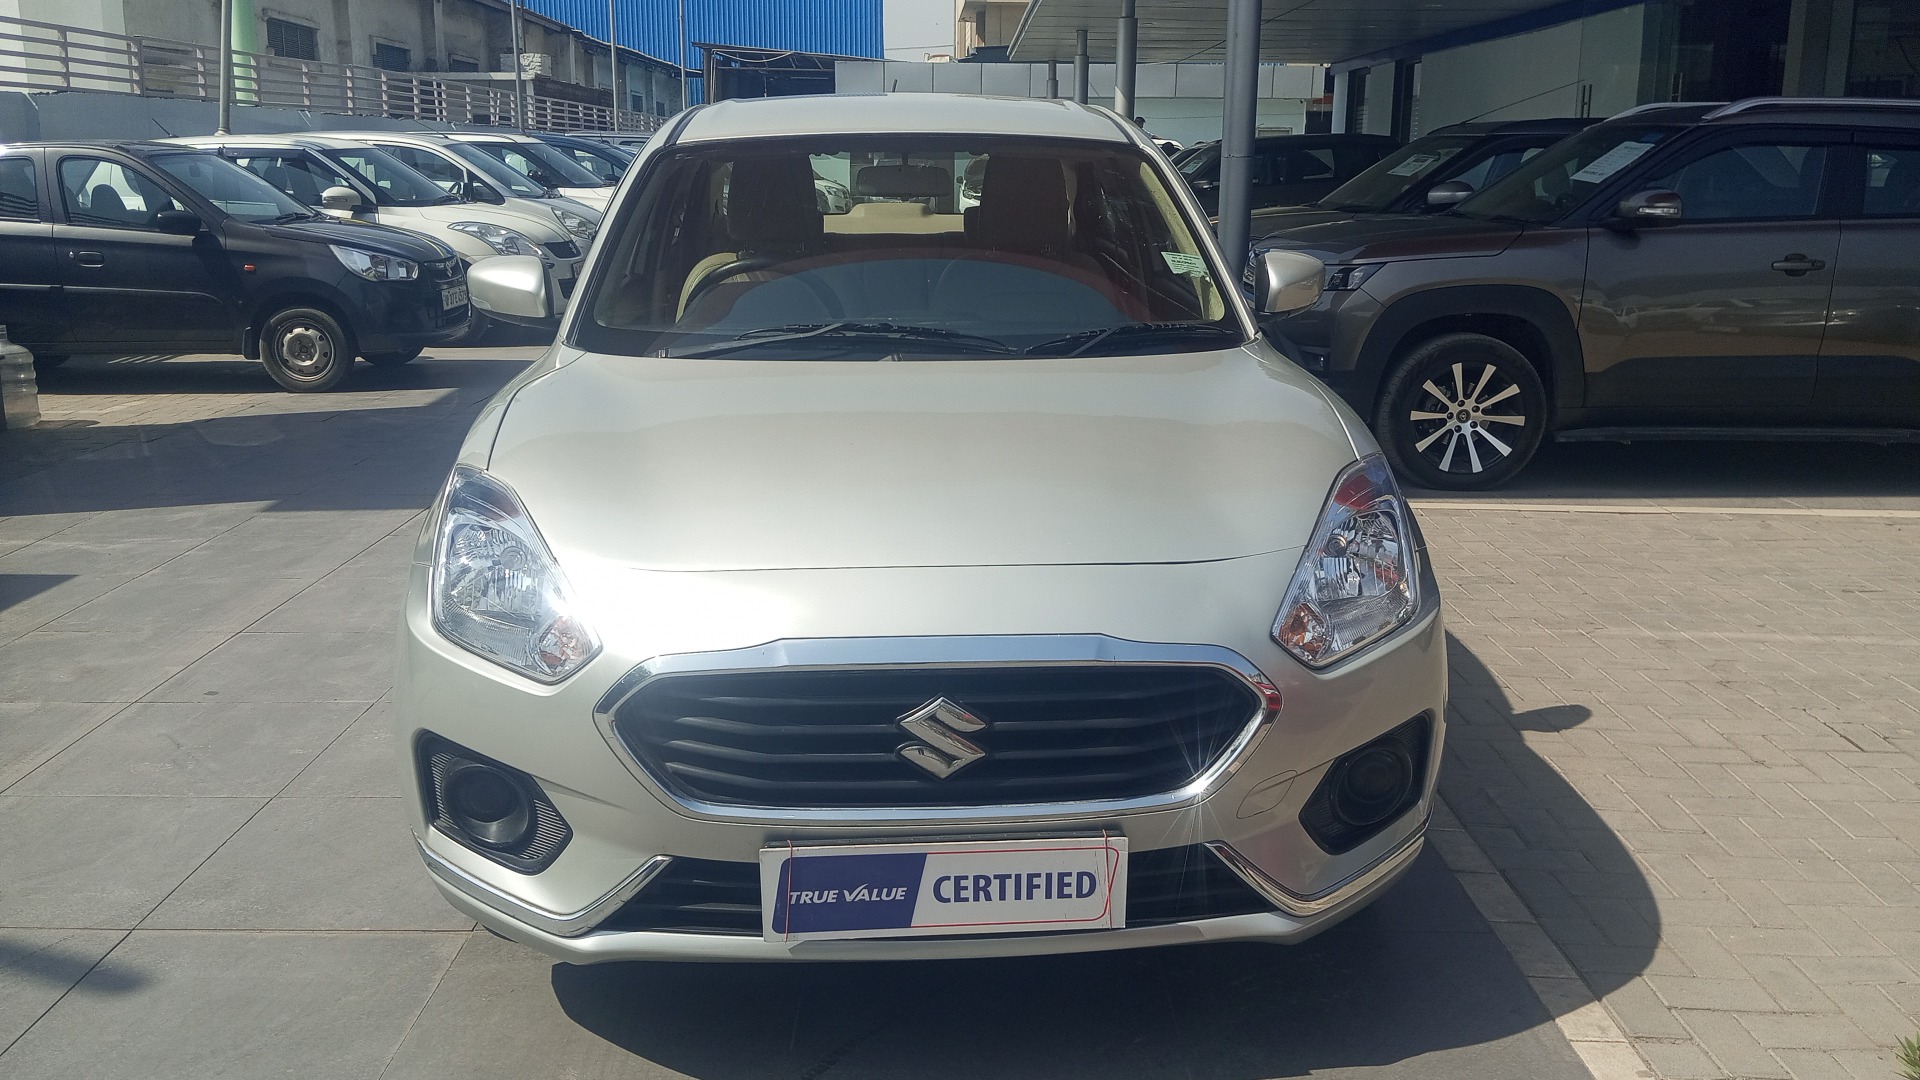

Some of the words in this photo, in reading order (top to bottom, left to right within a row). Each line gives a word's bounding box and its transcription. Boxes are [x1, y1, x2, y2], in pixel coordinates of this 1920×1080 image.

[790, 889, 839, 905] TRUE
[843, 883, 908, 902] VALUE
[932, 871, 1097, 904] CERTIFIED
